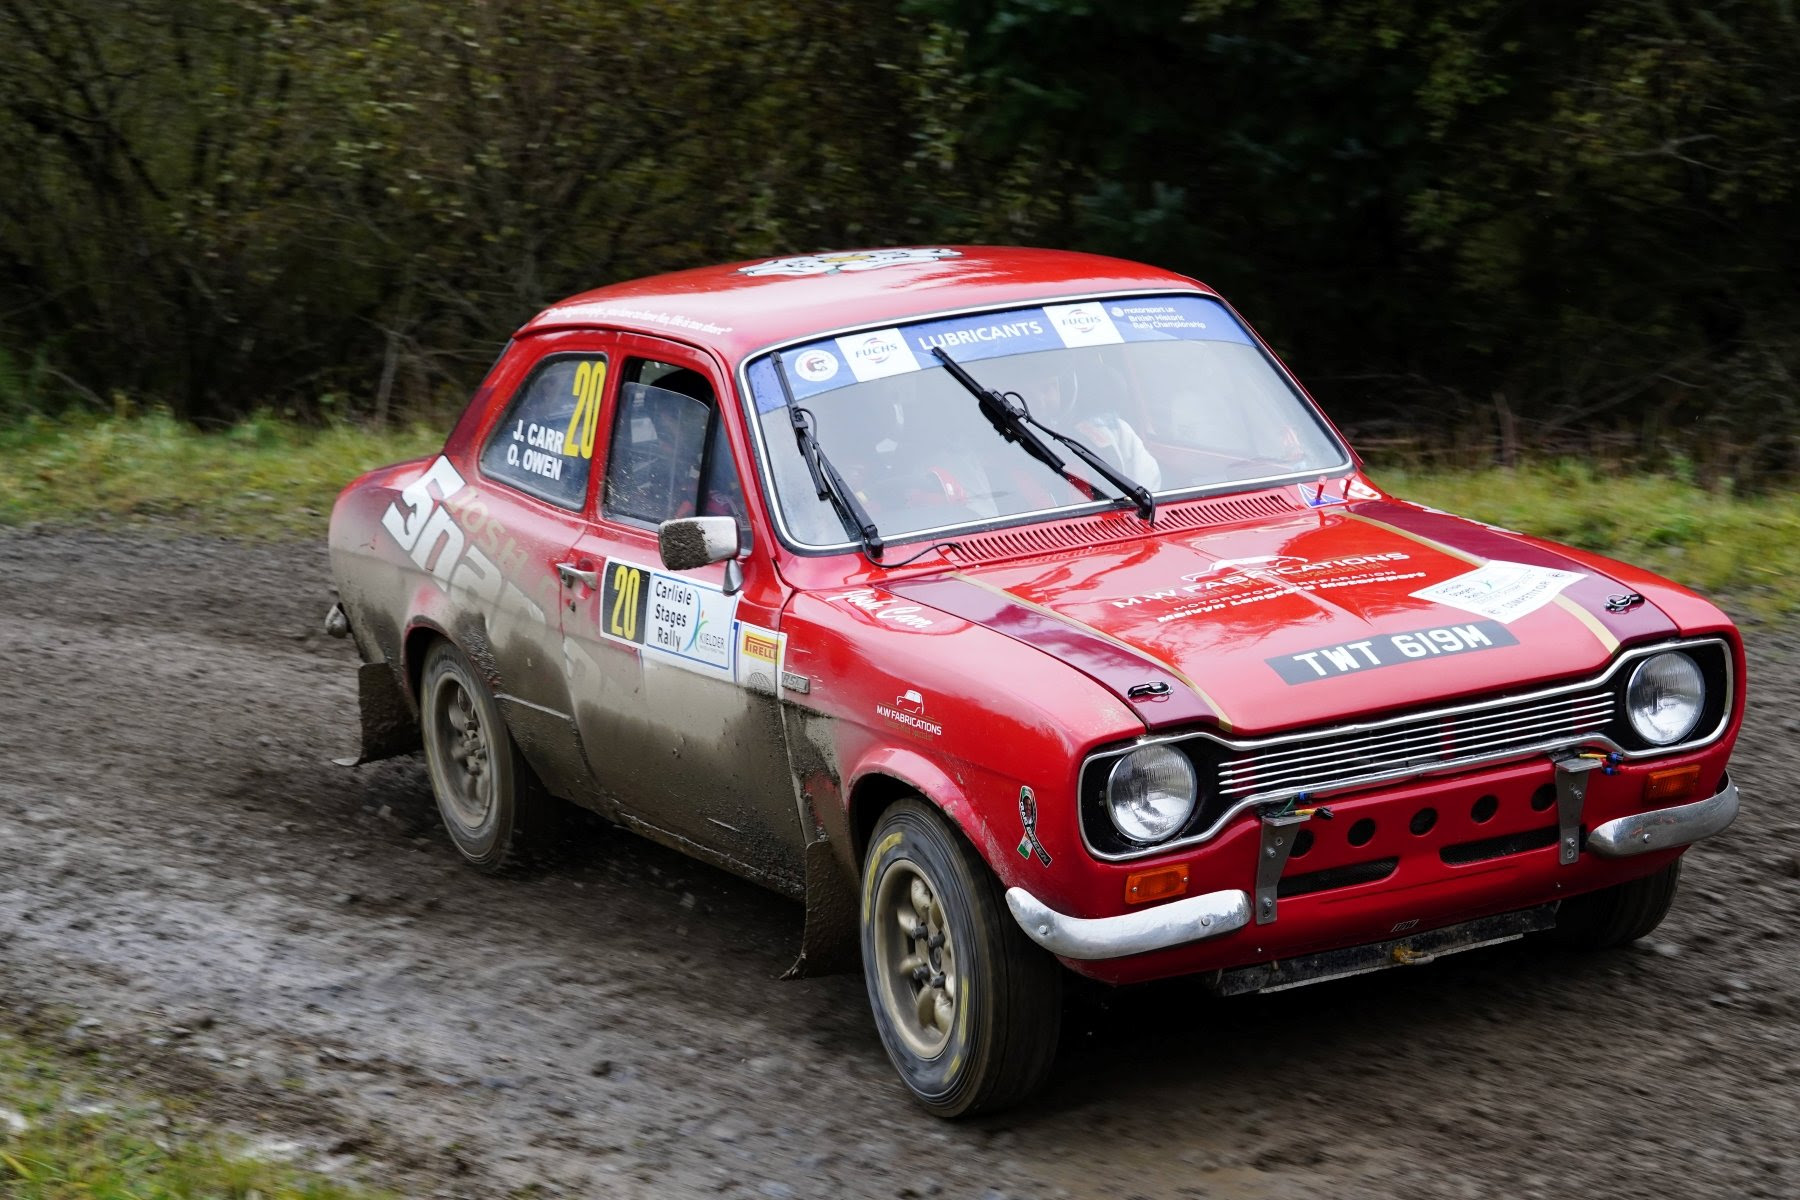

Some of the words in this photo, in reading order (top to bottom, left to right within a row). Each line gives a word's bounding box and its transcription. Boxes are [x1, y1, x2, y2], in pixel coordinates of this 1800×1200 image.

[917, 321, 1043, 351] LUBRICANTS
[1153, 321, 1207, 329] Championship
[855, 342, 898, 359] FUCHS
[563, 360, 607, 460] 20
[512, 419, 525, 442] J.
[527, 423, 565, 455] CARR
[507, 443, 519, 467] O.
[522, 448, 563, 481] OWEN
[1182, 551, 1411, 593] FABRICATIONS
[611, 564, 641, 641] 20
[655, 580, 692, 606] Carlisle
[1156, 602, 1226, 623] Melvyn
[1320, 571, 1427, 589] Motorsport
[1173, 583, 1283, 612] MOTORSPORT
[654, 603, 687, 628] Stages
[657, 625, 681, 652] Rally
[700, 631, 725, 650] KIELDER
[745, 634, 778, 660] PIRELLI
[1292, 640, 1382, 677] TWT
[1390, 623, 1494, 658] 619M
[890, 709, 942, 736] FABRICATIONS
